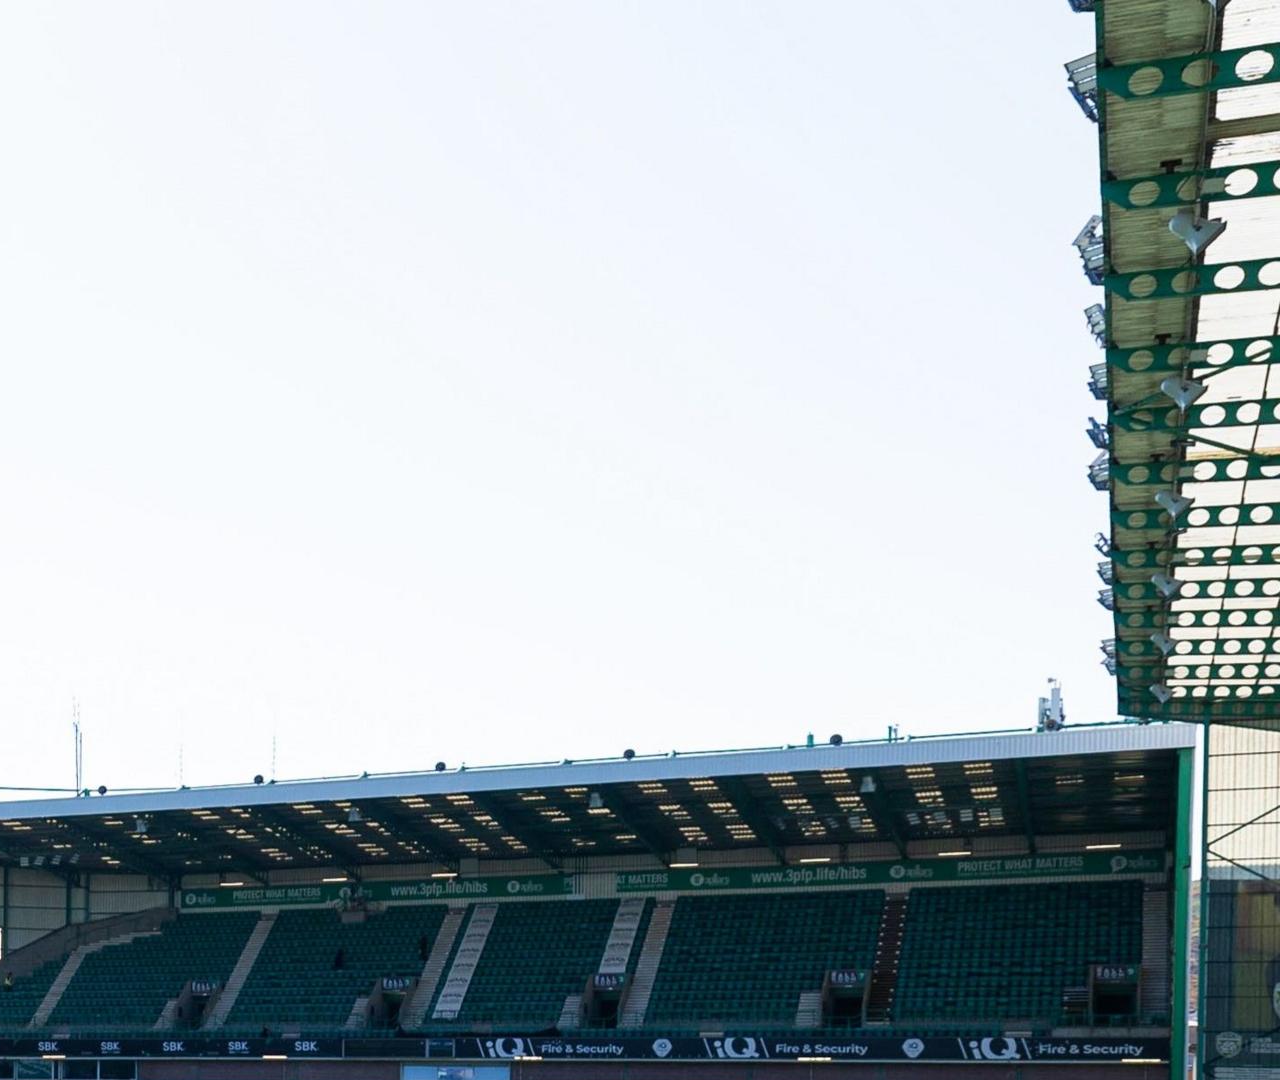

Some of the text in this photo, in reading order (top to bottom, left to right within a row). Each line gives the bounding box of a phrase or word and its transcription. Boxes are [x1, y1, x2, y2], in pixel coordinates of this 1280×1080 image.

[958, 856, 1083, 873] PROTECT WHAT MATTERS
[629, 873, 668, 884] MATTERS
[751, 867, 867, 884] www.3pfp.life/hibs
[233, 887, 320, 900] PROTECT WHAT MATTERS
[391, 881, 489, 899] www.3pfp.life/hibs
[38, 1042, 58, 1051] SBK
[100, 1042, 120, 1050] SBK
[163, 1042, 185, 1051] SBK
[229, 1042, 248, 1050] SBK
[295, 1042, 318, 1051] SBK
[486, 1038, 624, 1057] iQ Fire & Security
[714, 1037, 868, 1058] iQ Fire & Security
[969, 1037, 1143, 1059] iQ Fire & Security
